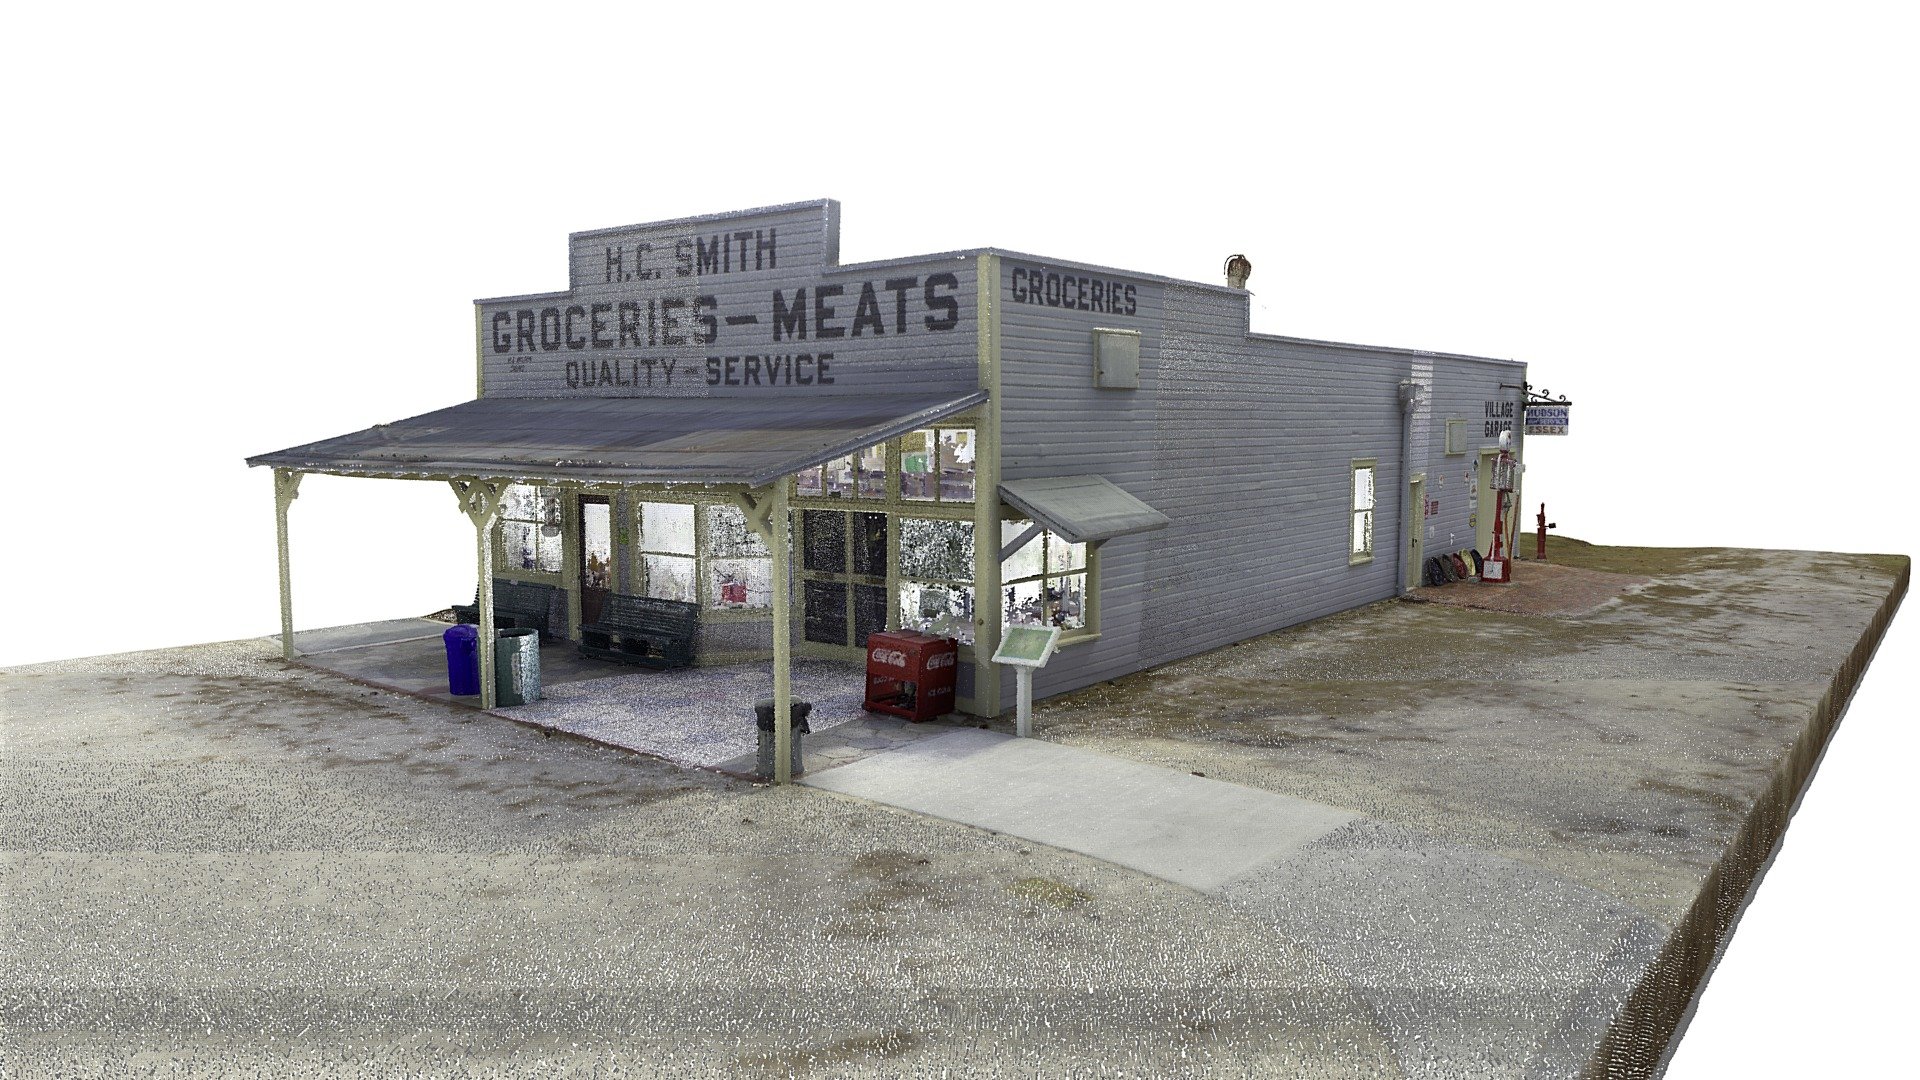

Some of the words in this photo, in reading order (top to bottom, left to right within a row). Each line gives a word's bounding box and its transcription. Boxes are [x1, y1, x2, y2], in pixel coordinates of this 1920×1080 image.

[675, 228, 776, 278] SMITH
[772, 273, 959, 342] MEATS
[1012, 267, 1137, 316] GROCERIES
[565, 358, 676, 389] QUALITY
[705, 353, 835, 386] SERVICE
[1485, 401, 1514, 418] VILLAGE
[1526, 408, 1567, 417] HUDSON
[1528, 426, 1564, 434] ESSEX
